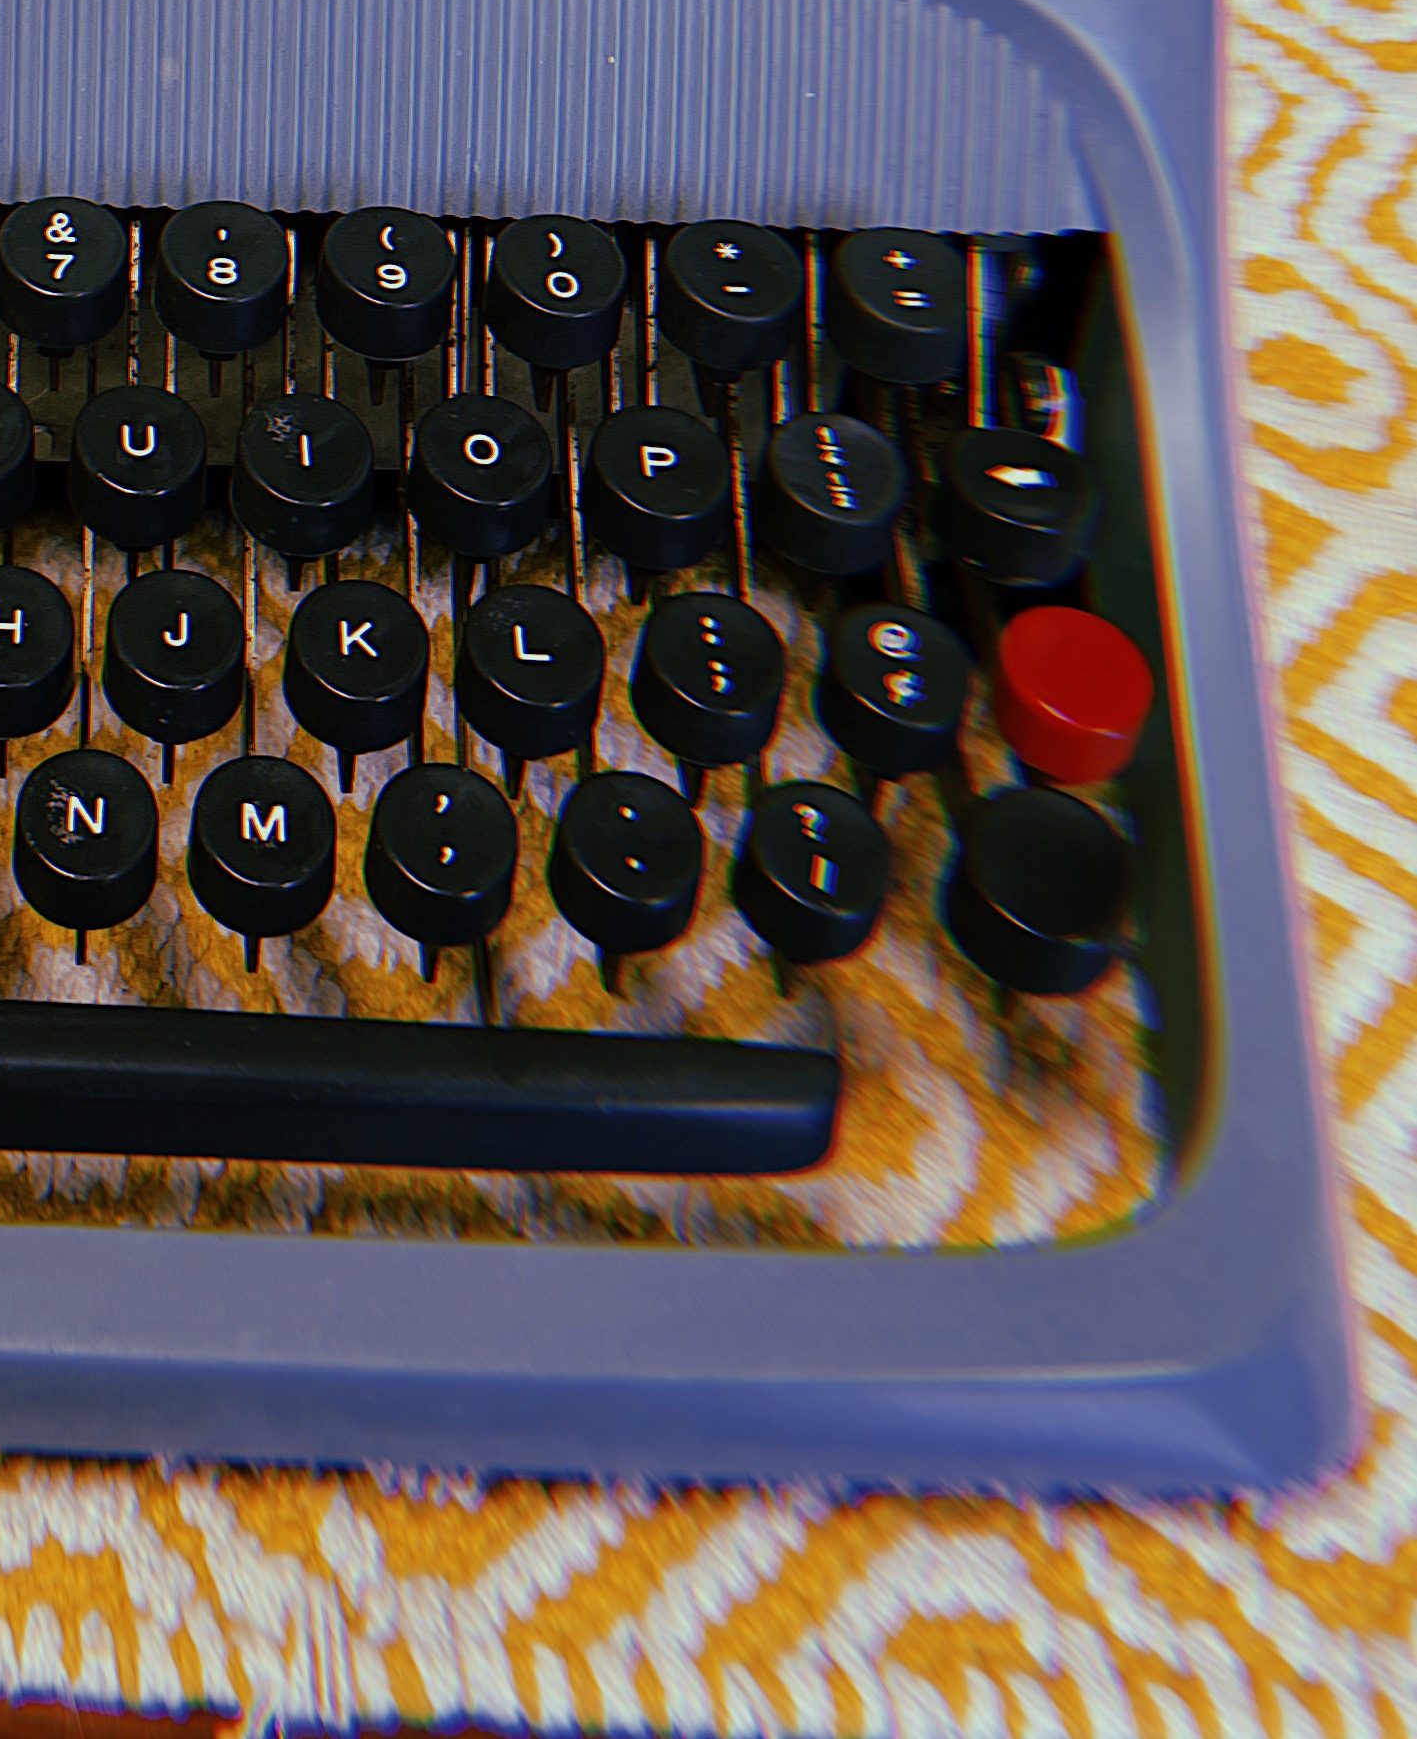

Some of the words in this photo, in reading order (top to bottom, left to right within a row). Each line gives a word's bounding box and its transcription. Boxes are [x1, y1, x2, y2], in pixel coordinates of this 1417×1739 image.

[43, 212, 79, 243] &
[45, 253, 77, 280] 7
[206, 257, 240, 285] 8
[375, 264, 409, 290] 9
[120, 424, 158, 457] U
[299, 434, 313, 467] I
[463, 433, 502, 465] O
[639, 445, 680, 478] P
[162, 612, 191, 647] J
[339, 620, 380, 657] K
[512, 625, 554, 662] L
[65, 794, 108, 835] N
[240, 802, 289, 843] M
